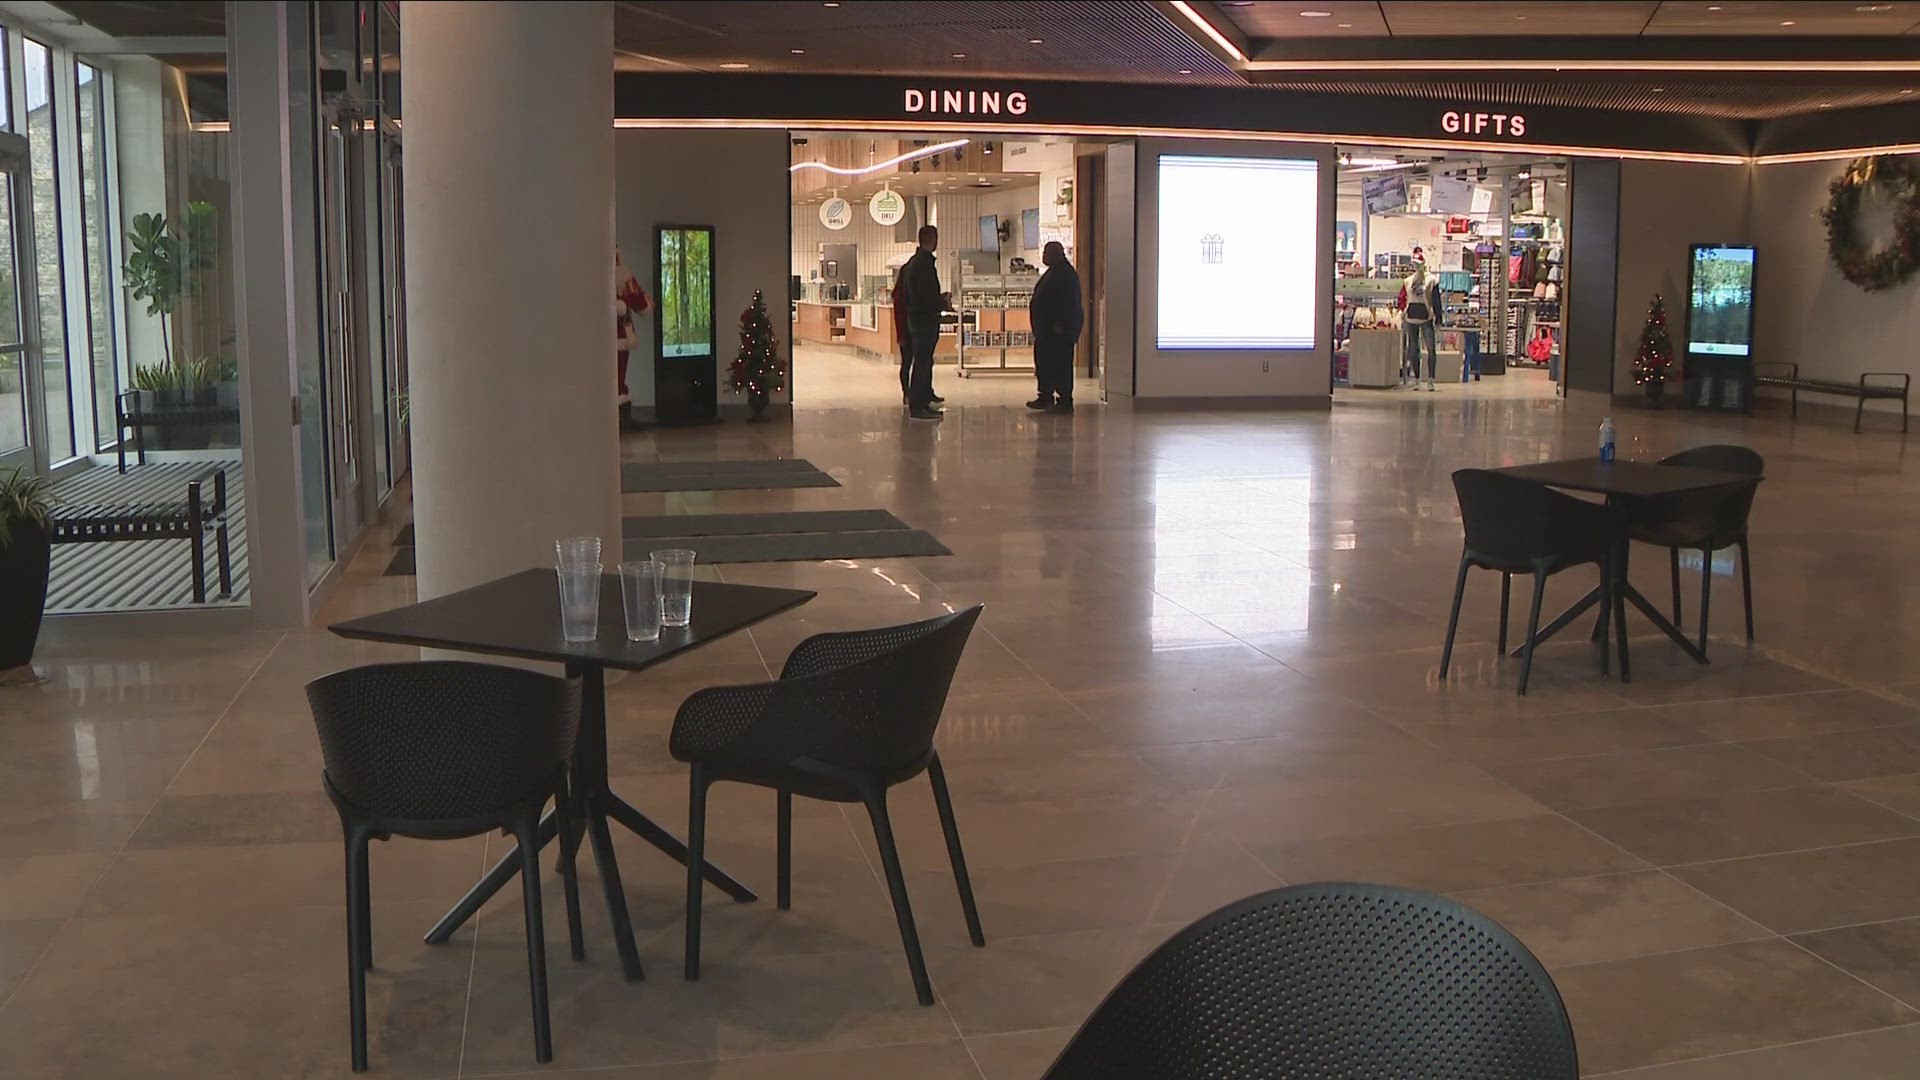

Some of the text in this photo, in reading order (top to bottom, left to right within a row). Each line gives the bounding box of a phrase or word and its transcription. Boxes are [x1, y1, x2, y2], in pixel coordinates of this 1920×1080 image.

[905, 89, 1027, 114] DINING
[1442, 111, 1526, 136] GIFTS
[1507, 307, 1518, 327] FALLS
